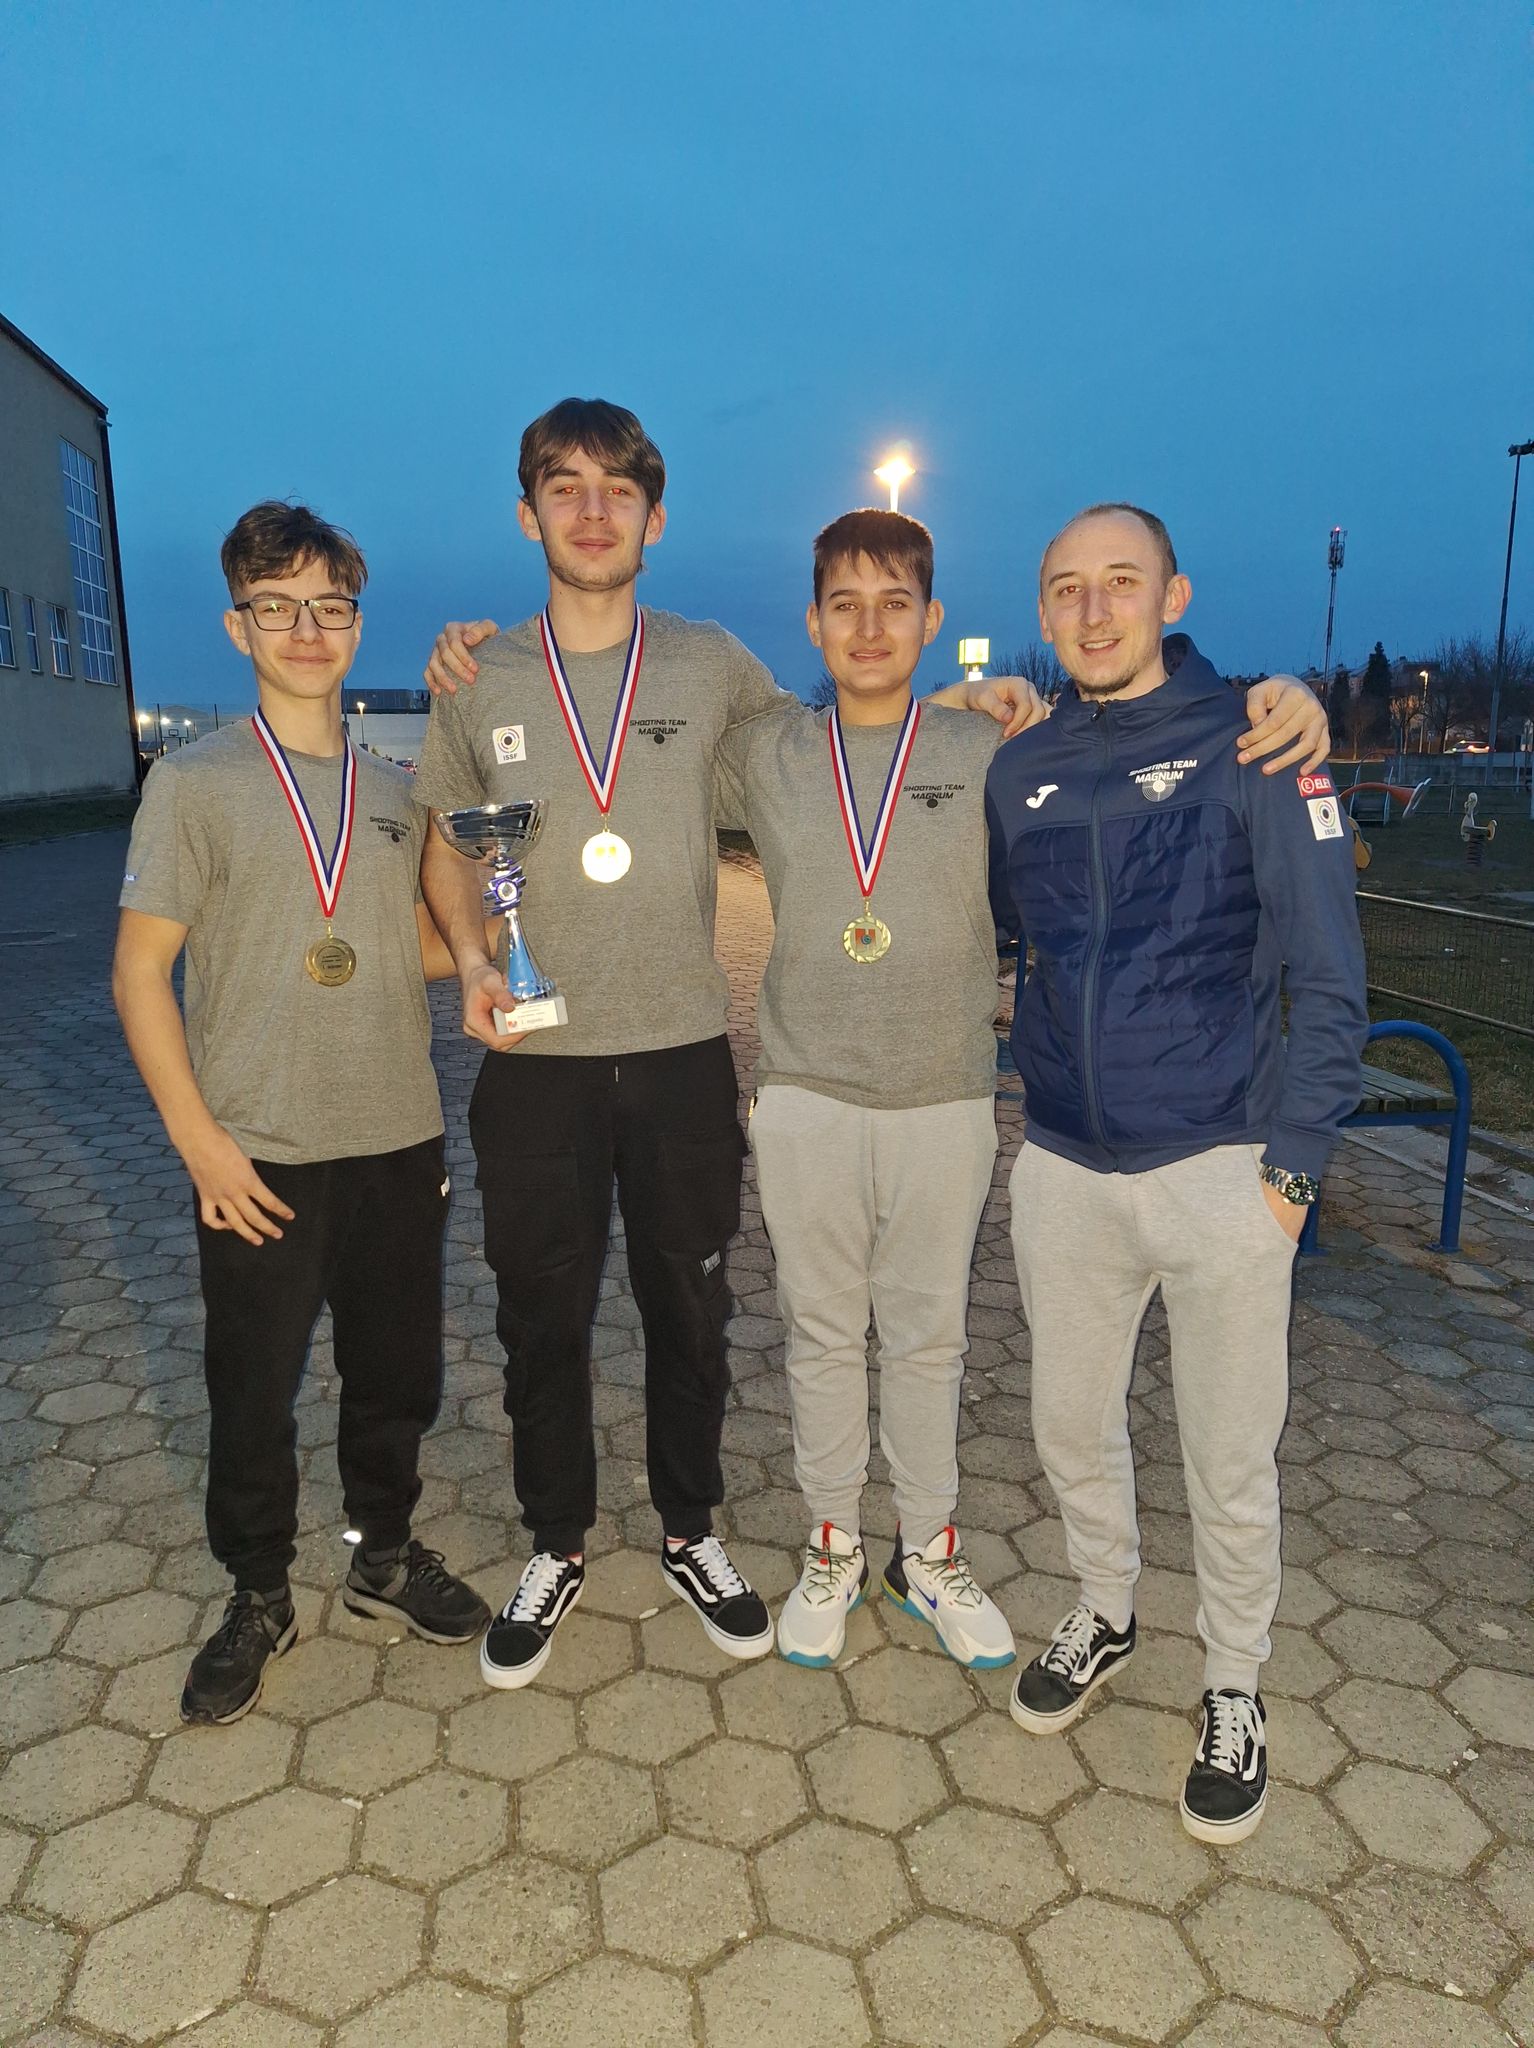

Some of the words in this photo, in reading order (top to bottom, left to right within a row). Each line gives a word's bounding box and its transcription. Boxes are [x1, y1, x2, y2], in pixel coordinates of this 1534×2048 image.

[638, 727, 678, 735] MAGNUM
[1128, 761, 1172, 777] SHOOTING
[1172, 759, 1198, 769] TEAM
[1134, 770, 1184, 784] MAGNUM
[903, 784, 942, 792] SHOOTING
[944, 783, 965, 791] TEAM
[911, 792, 954, 800] MAGNUM
